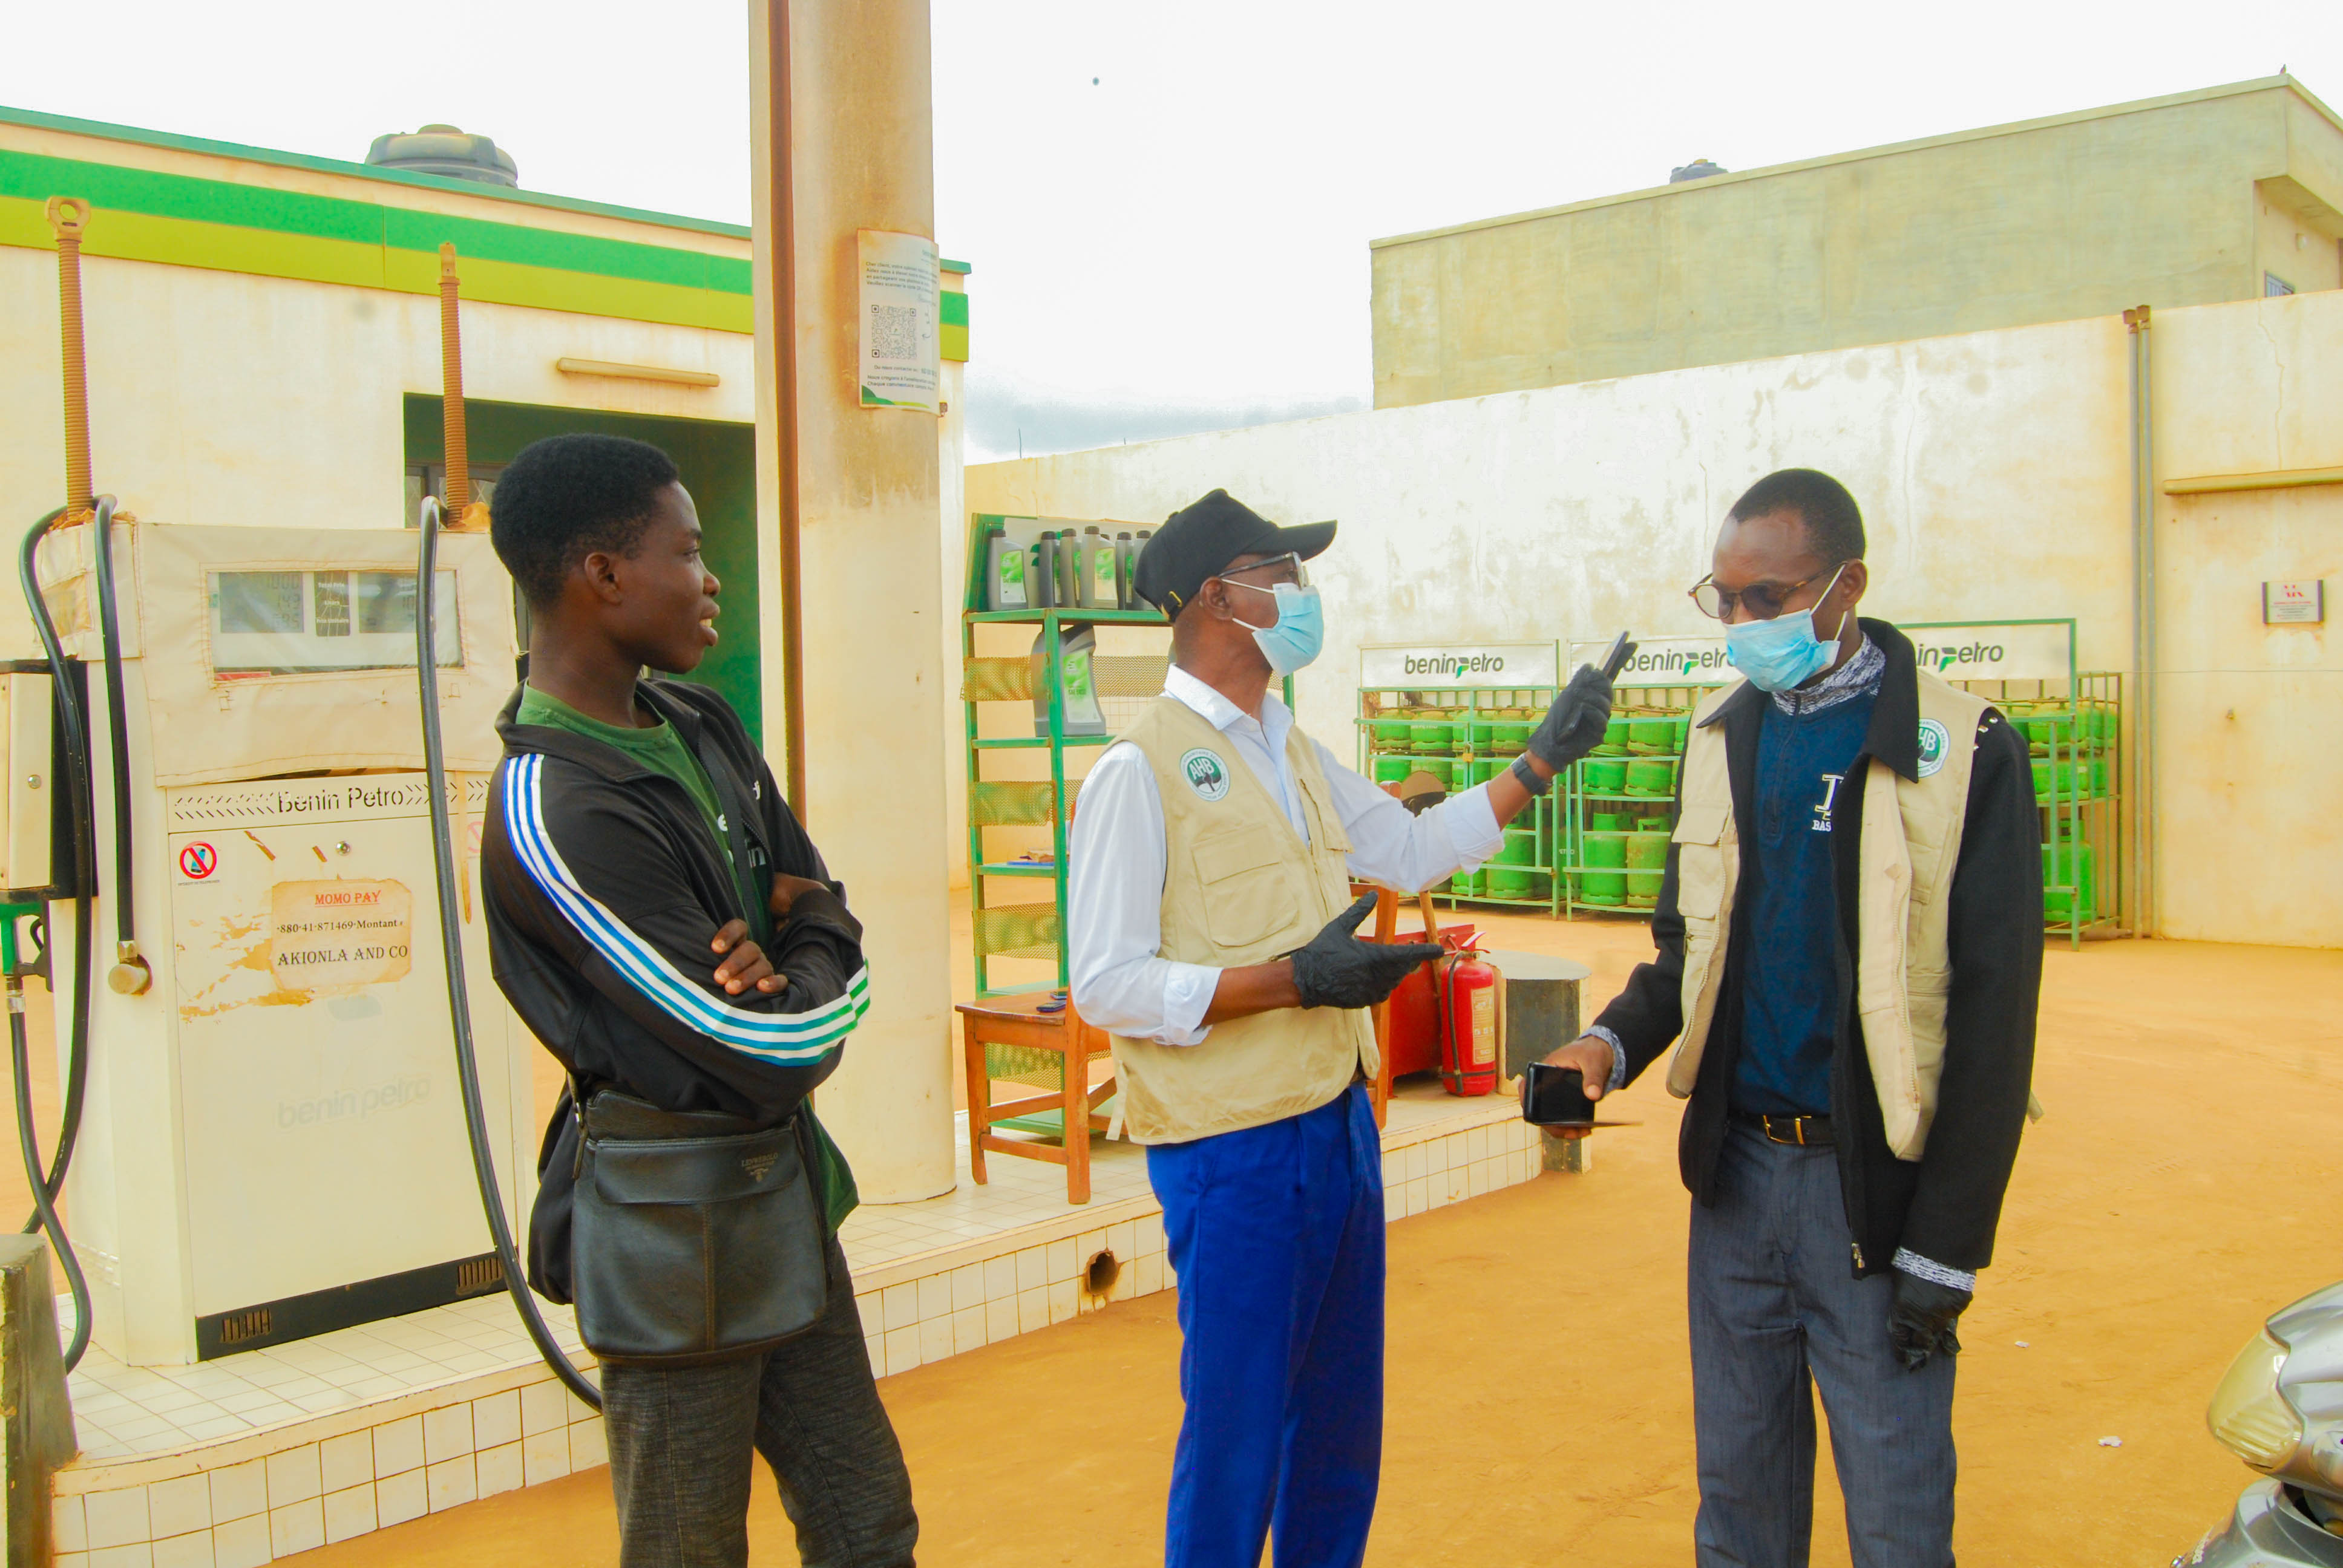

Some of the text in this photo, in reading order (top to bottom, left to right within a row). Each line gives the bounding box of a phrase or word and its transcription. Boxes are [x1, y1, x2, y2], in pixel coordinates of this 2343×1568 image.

[1918, 728, 1937, 751] HB
[1189, 757, 1215, 780] AHB
[278, 787, 403, 812] Benin Petro
[315, 890, 381, 905] MOMO PAY
[278, 944, 408, 965] AKIONLA AND CO
[277, 1076, 431, 1129] benin petro
